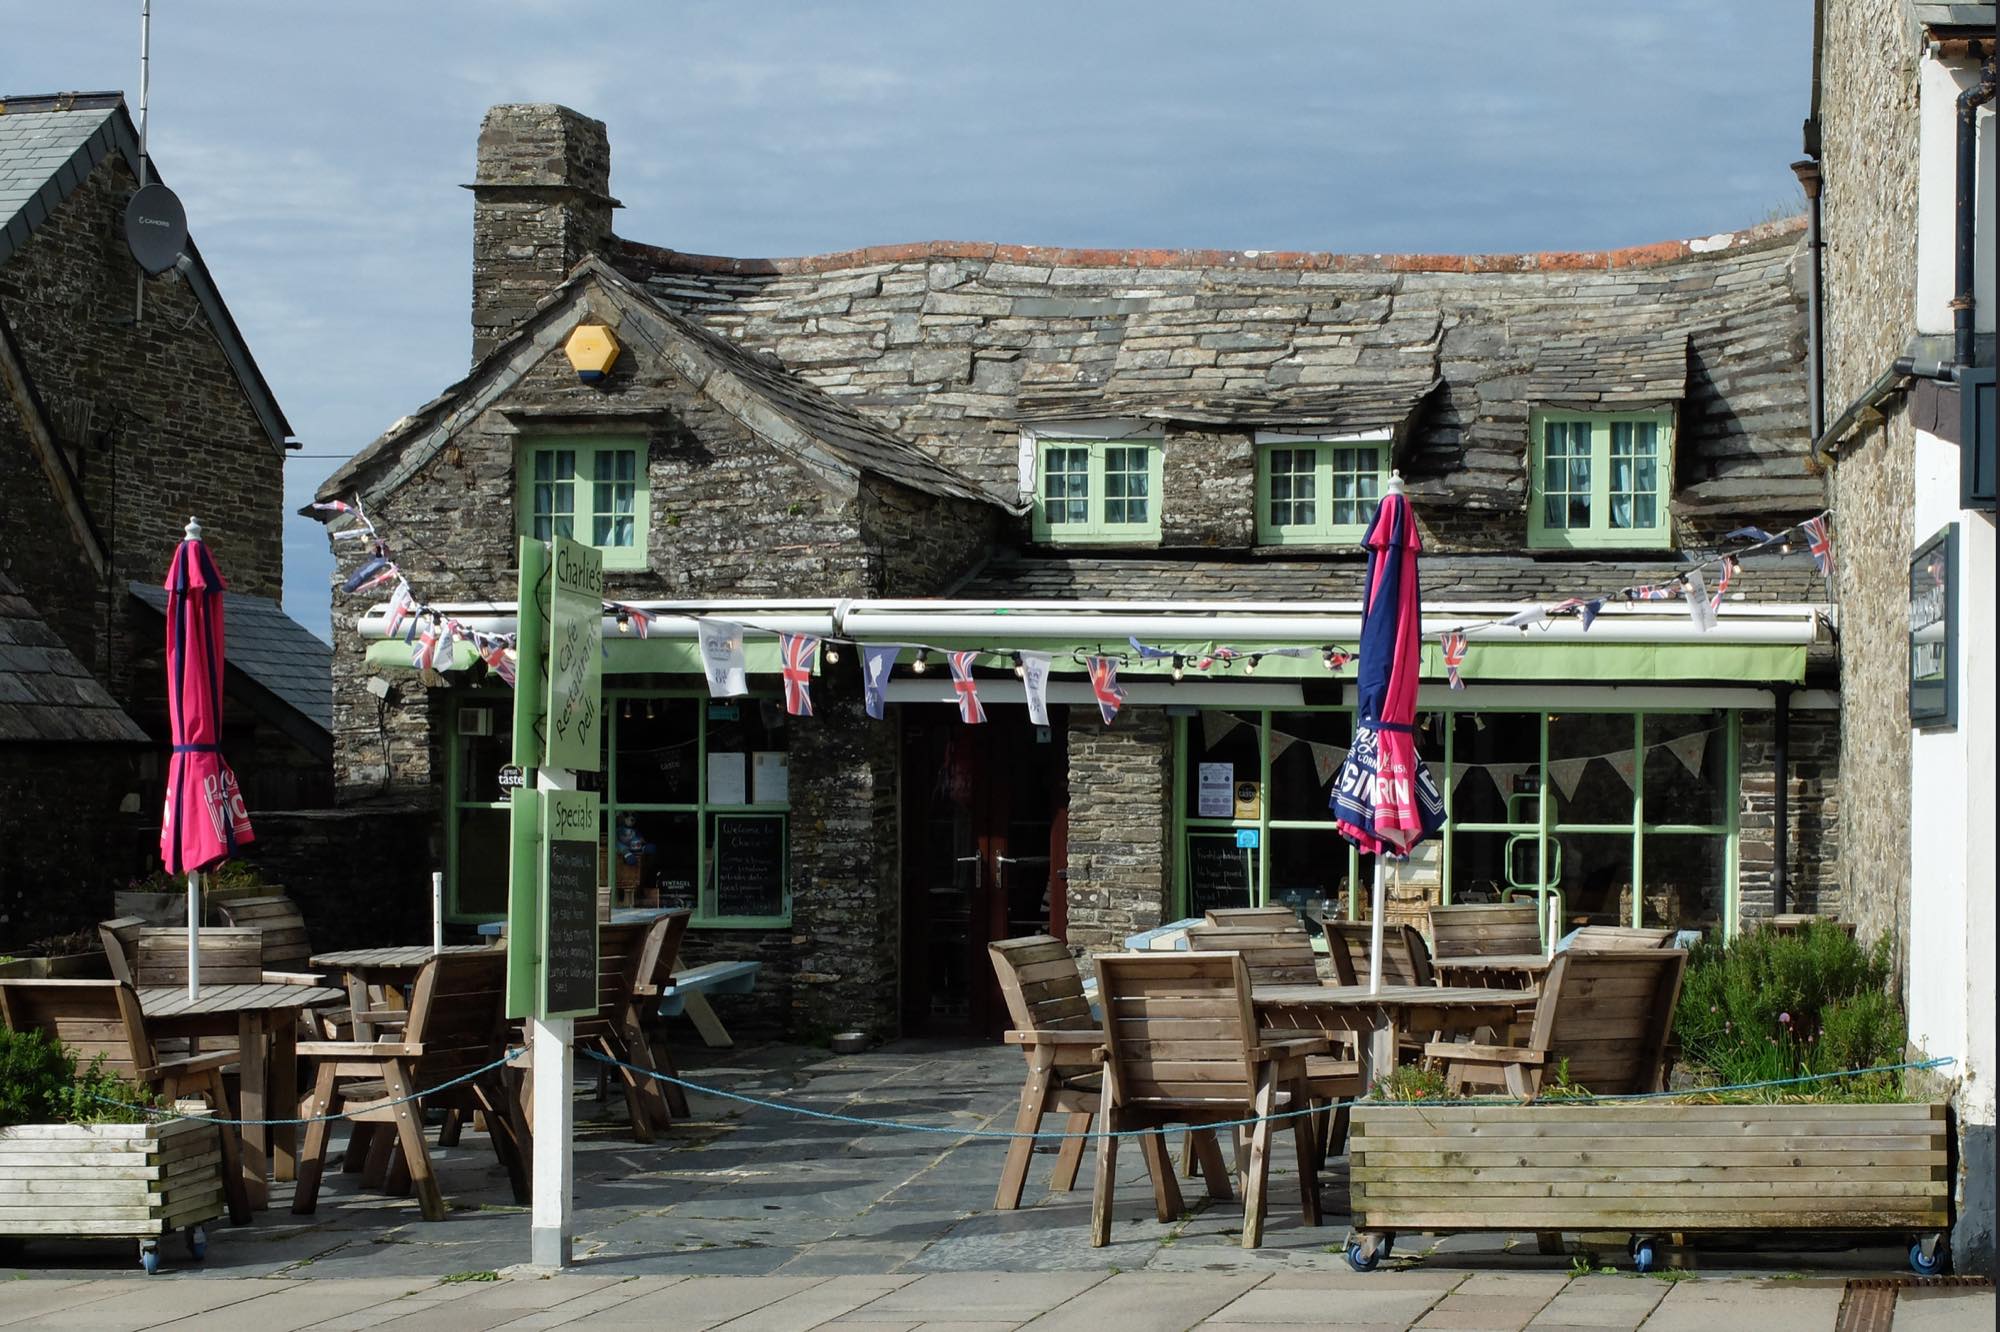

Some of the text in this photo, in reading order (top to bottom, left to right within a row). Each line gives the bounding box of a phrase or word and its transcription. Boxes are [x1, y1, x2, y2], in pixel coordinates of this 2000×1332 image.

[557, 547, 601, 593] Charlie's
[556, 617, 598, 742] Restaurant
[578, 695, 595, 746] Deli
[498, 774, 524, 785] taste
[556, 797, 593, 835] Specials
